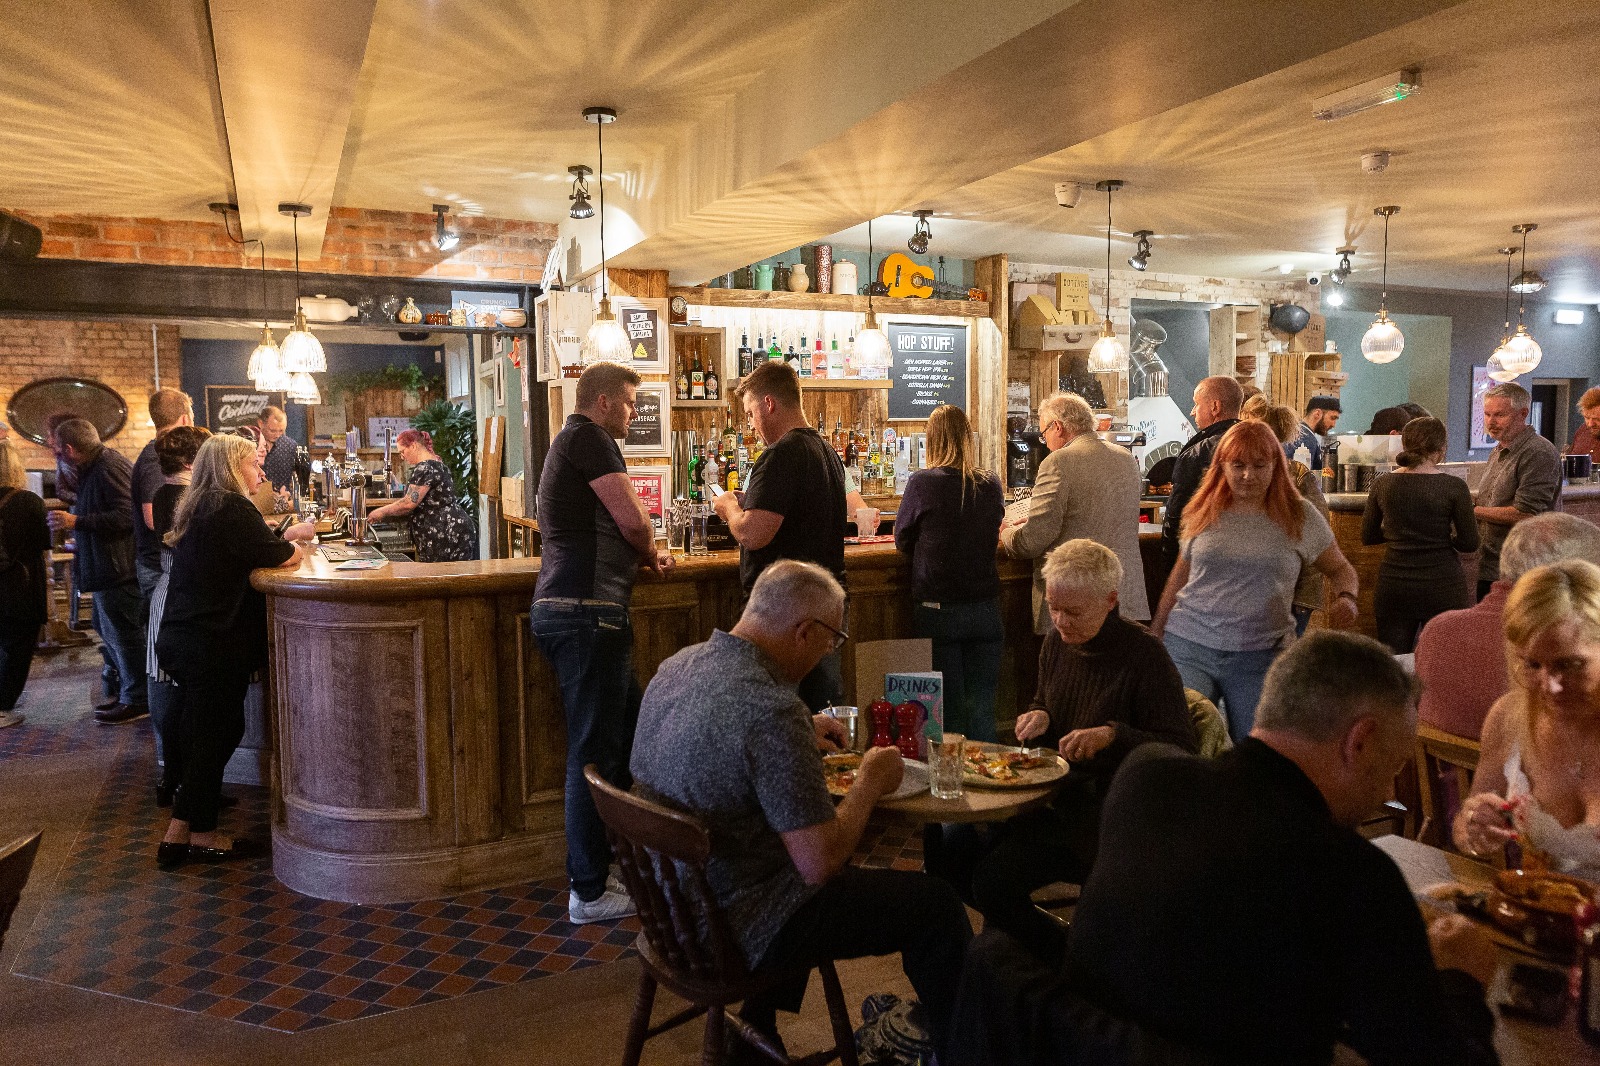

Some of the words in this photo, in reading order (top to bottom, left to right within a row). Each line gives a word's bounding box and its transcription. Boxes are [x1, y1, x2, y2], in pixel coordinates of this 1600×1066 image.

[897, 334, 917, 350] HOP
[920, 335, 955, 351] STUFF!
[888, 677, 940, 695] DRINKS
